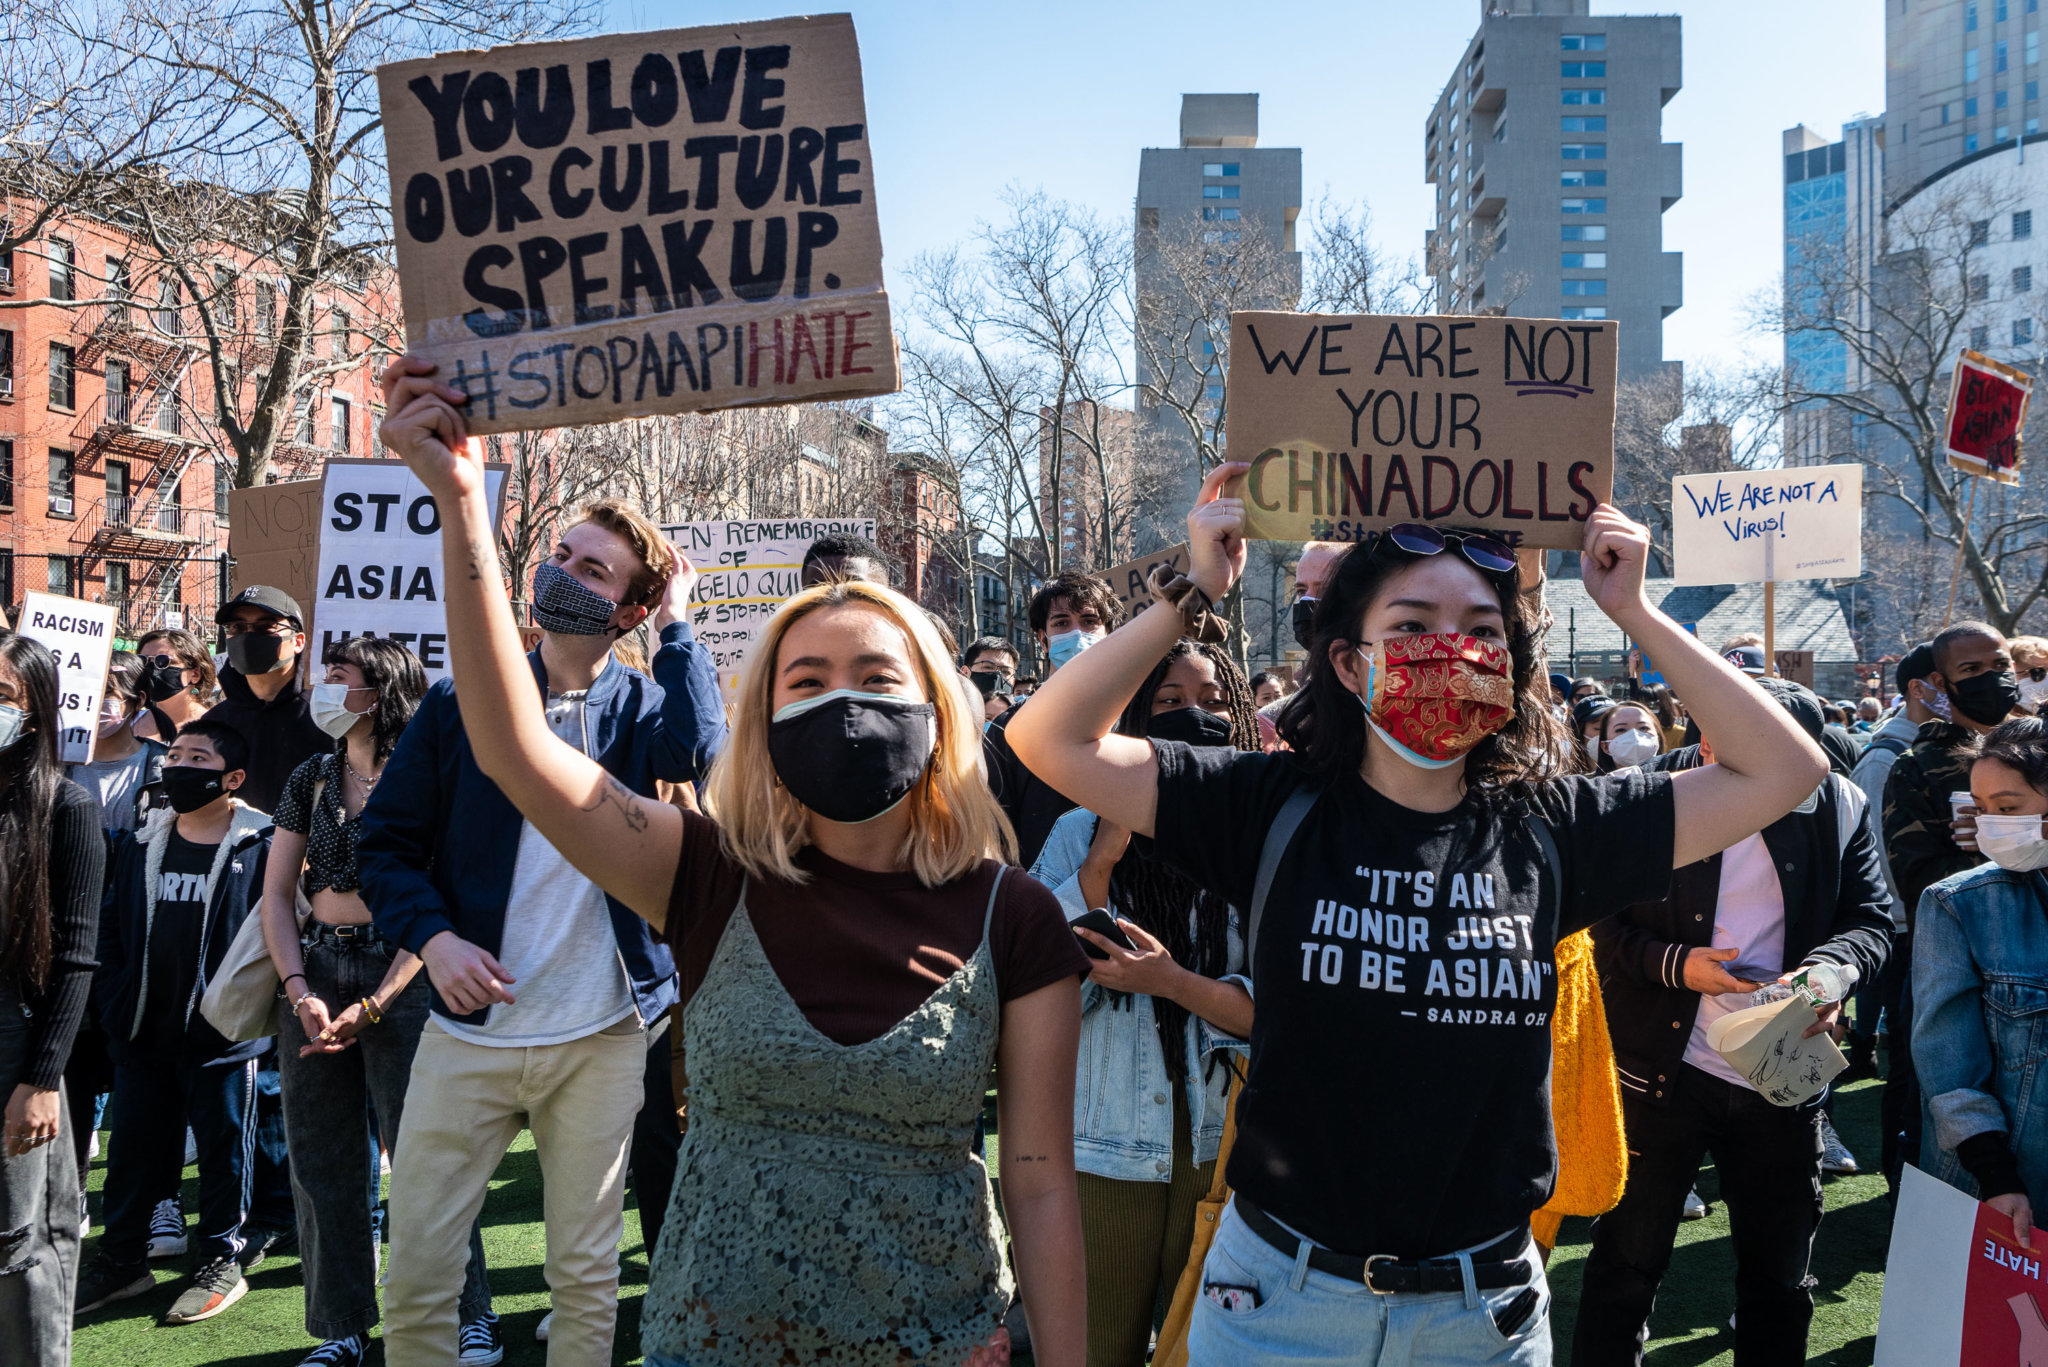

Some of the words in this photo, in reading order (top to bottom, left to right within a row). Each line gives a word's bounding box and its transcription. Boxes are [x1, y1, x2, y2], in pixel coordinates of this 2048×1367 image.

[408, 64, 575, 162] YOU
[586, 45, 791, 135] LOVE
[405, 155, 543, 243] OUR
[548, 124, 863, 219] CULTURE
[463, 218, 724, 339] SPEAK
[729, 212, 842, 303] UP.
[1247, 323, 1353, 377] WE
[1374, 322, 1479, 379] ARE
[1505, 323, 1604, 387] NOT
[1335, 387, 1482, 450] YOUR
[1248, 448, 1598, 522] CHINADOLLS
[1779, 481, 1816, 505] NOT
[1817, 480, 1838, 503] A
[331, 492, 442, 536] STO
[719, 551, 747, 568] OF
[324, 564, 446, 602] ASIA
[688, 572, 748, 604] NGELO
[32, 611, 104, 637] RACISM
[67, 652, 83, 670] A
[1449, 873, 1496, 909] AN
[1311, 899, 1430, 952] HONOR
[1447, 914, 1534, 951] JUST
[1301, 941, 1344, 985] TO
[1359, 950, 1406, 993] BE
[1427, 1007, 1517, 1026] SANDRA
[1525, 1012, 1547, 1026] OH
[1983, 1239, 2040, 1280] HATE
